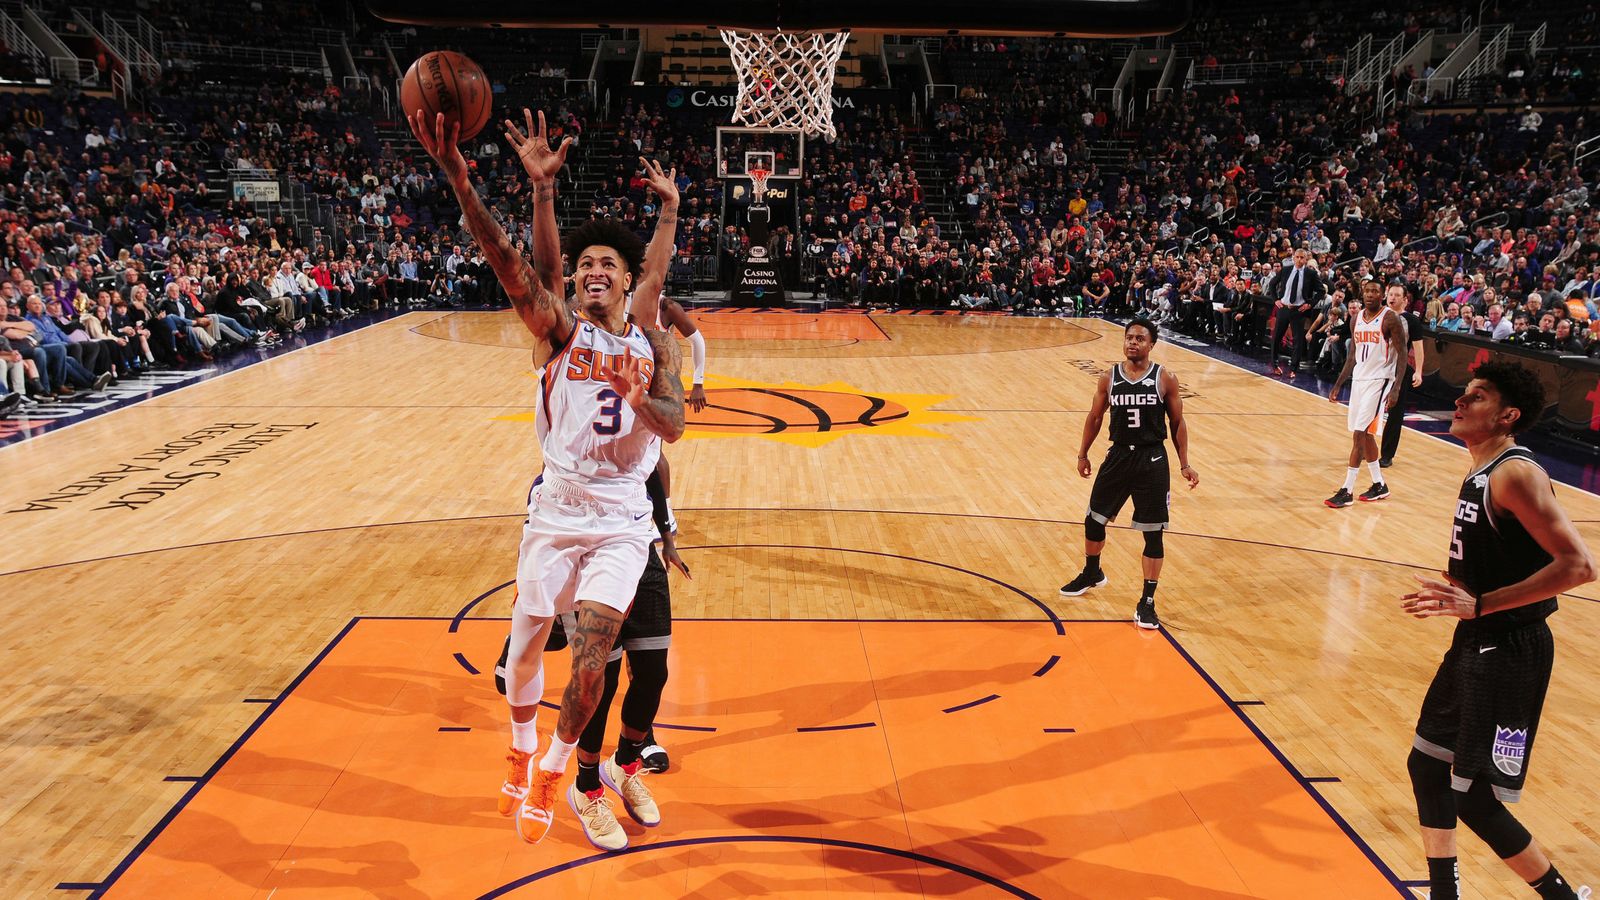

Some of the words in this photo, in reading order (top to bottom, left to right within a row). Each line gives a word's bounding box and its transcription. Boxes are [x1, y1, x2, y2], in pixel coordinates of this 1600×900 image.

[690, 91, 750, 108] CASI
[741, 277, 778, 285] ARIZONA
[744, 268, 775, 277] CASINO
[1354, 331, 1380, 344] SUNS
[1362, 344, 1369, 362] 11
[1110, 393, 1157, 406] KINGS
[592, 388, 623, 436] 3
[1127, 408, 1140, 428] 3
[133, 422, 261, 462] RESORT
[190, 421, 319, 467] TALKING
[5, 463, 160, 514] ARENA
[89, 470, 222, 511] STICK
[1494, 745, 1525, 758] KING
